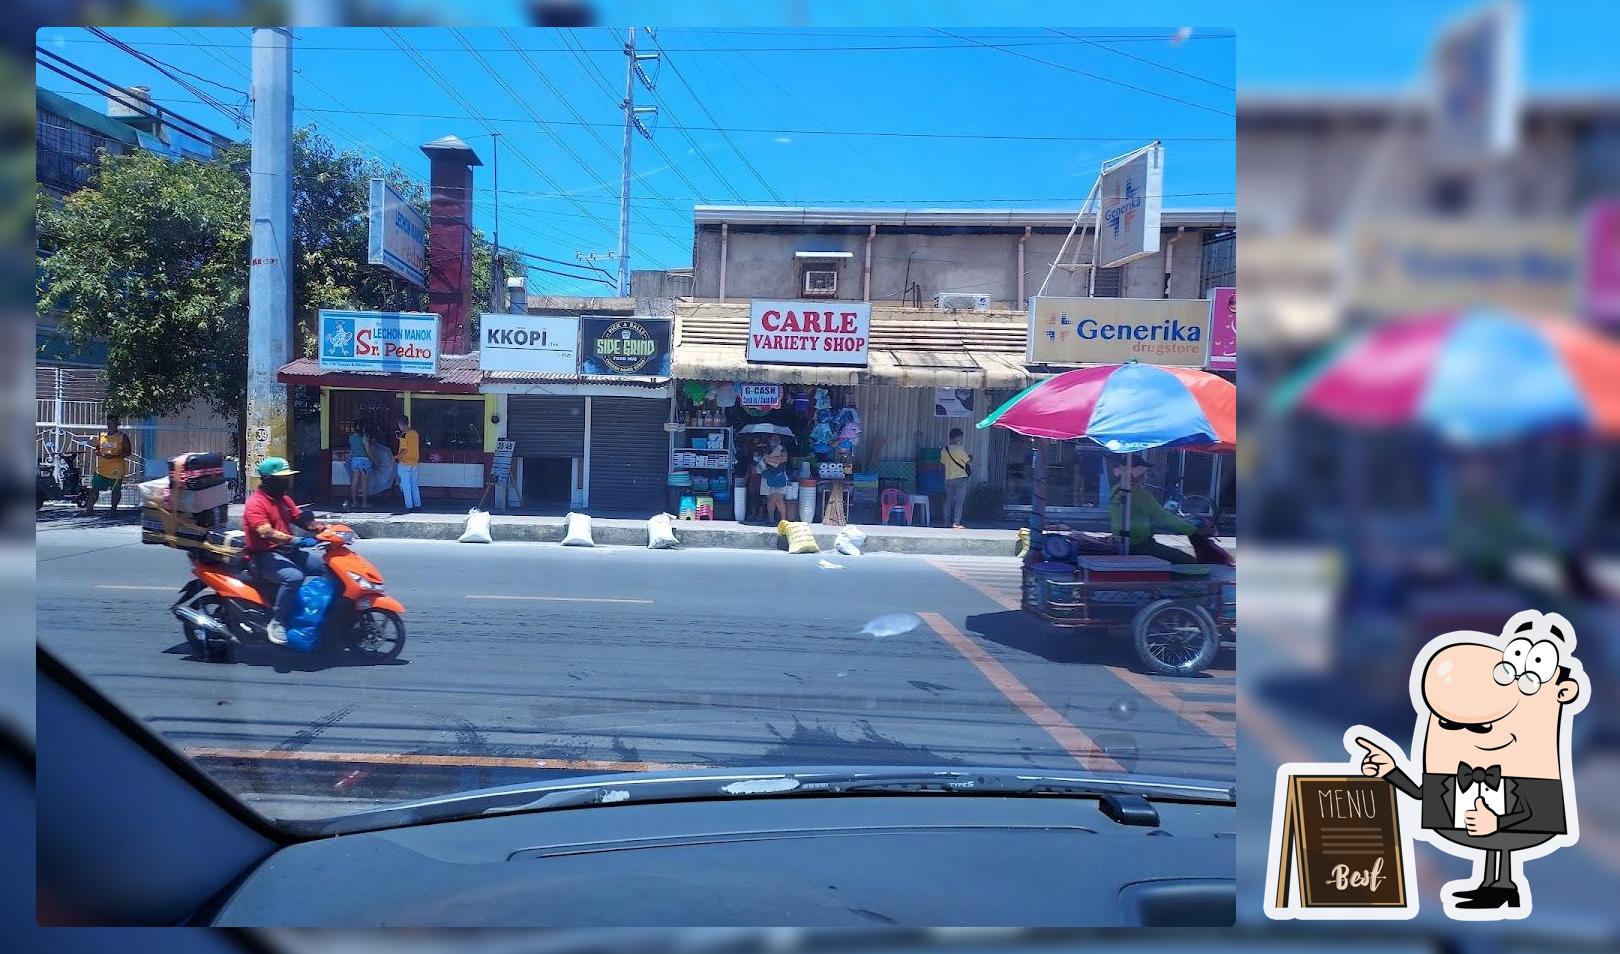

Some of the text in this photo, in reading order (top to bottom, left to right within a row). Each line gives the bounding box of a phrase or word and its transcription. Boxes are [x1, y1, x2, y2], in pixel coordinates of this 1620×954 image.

[761, 310, 858, 334] CARLE
[1076, 319, 1201, 342] Generika
[373, 327, 432, 341] LECHON MANOK
[752, 334, 865, 352] VARIETY SHOP
[356, 328, 432, 359] Sr. Pedro
[596, 338, 656, 356] SIDE GRIND
[1132, 341, 1200, 356] drugstore
[745, 386, 776, 395] G-CASH
